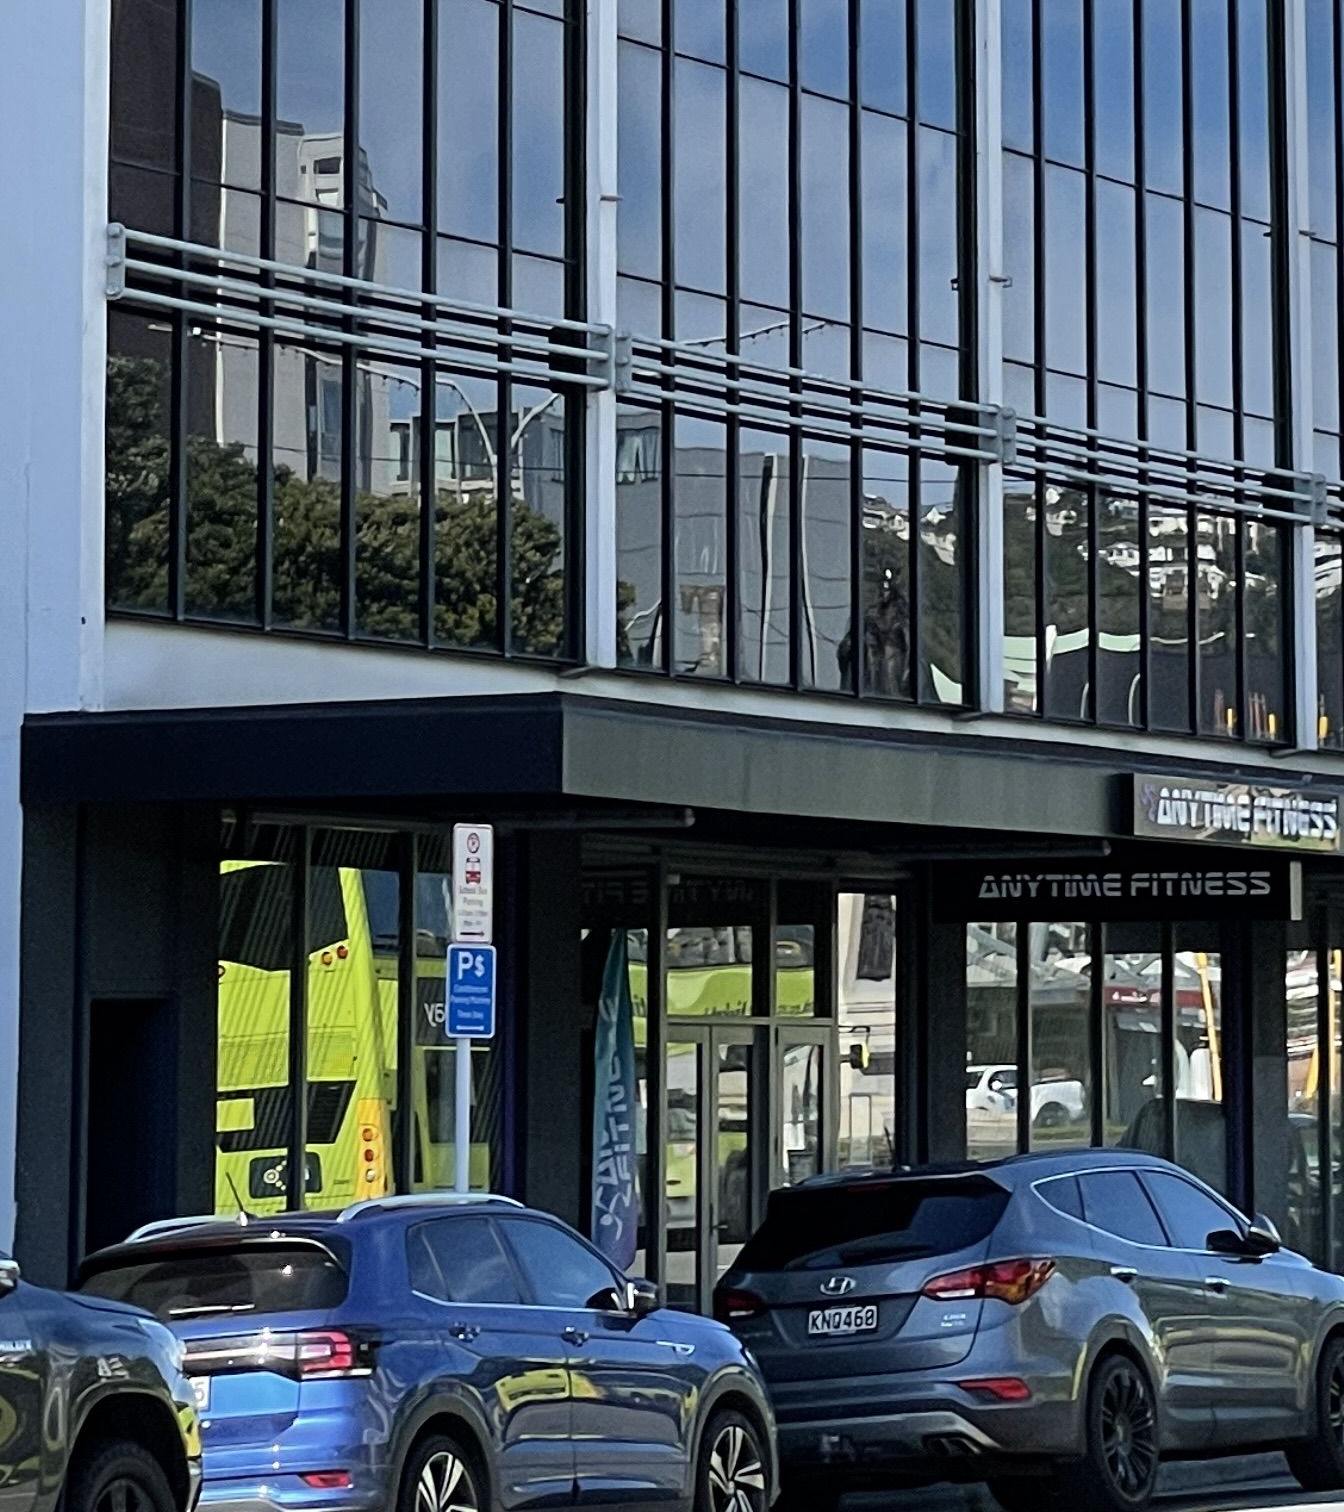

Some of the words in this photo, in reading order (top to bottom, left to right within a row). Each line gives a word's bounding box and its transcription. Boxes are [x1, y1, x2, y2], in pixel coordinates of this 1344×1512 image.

[1157, 787, 1251, 832] ANYTIME
[1254, 796, 1337, 839] FITNESS
[978, 874, 1122, 898] ANYTIME
[1131, 871, 1271, 896] FITNESS
